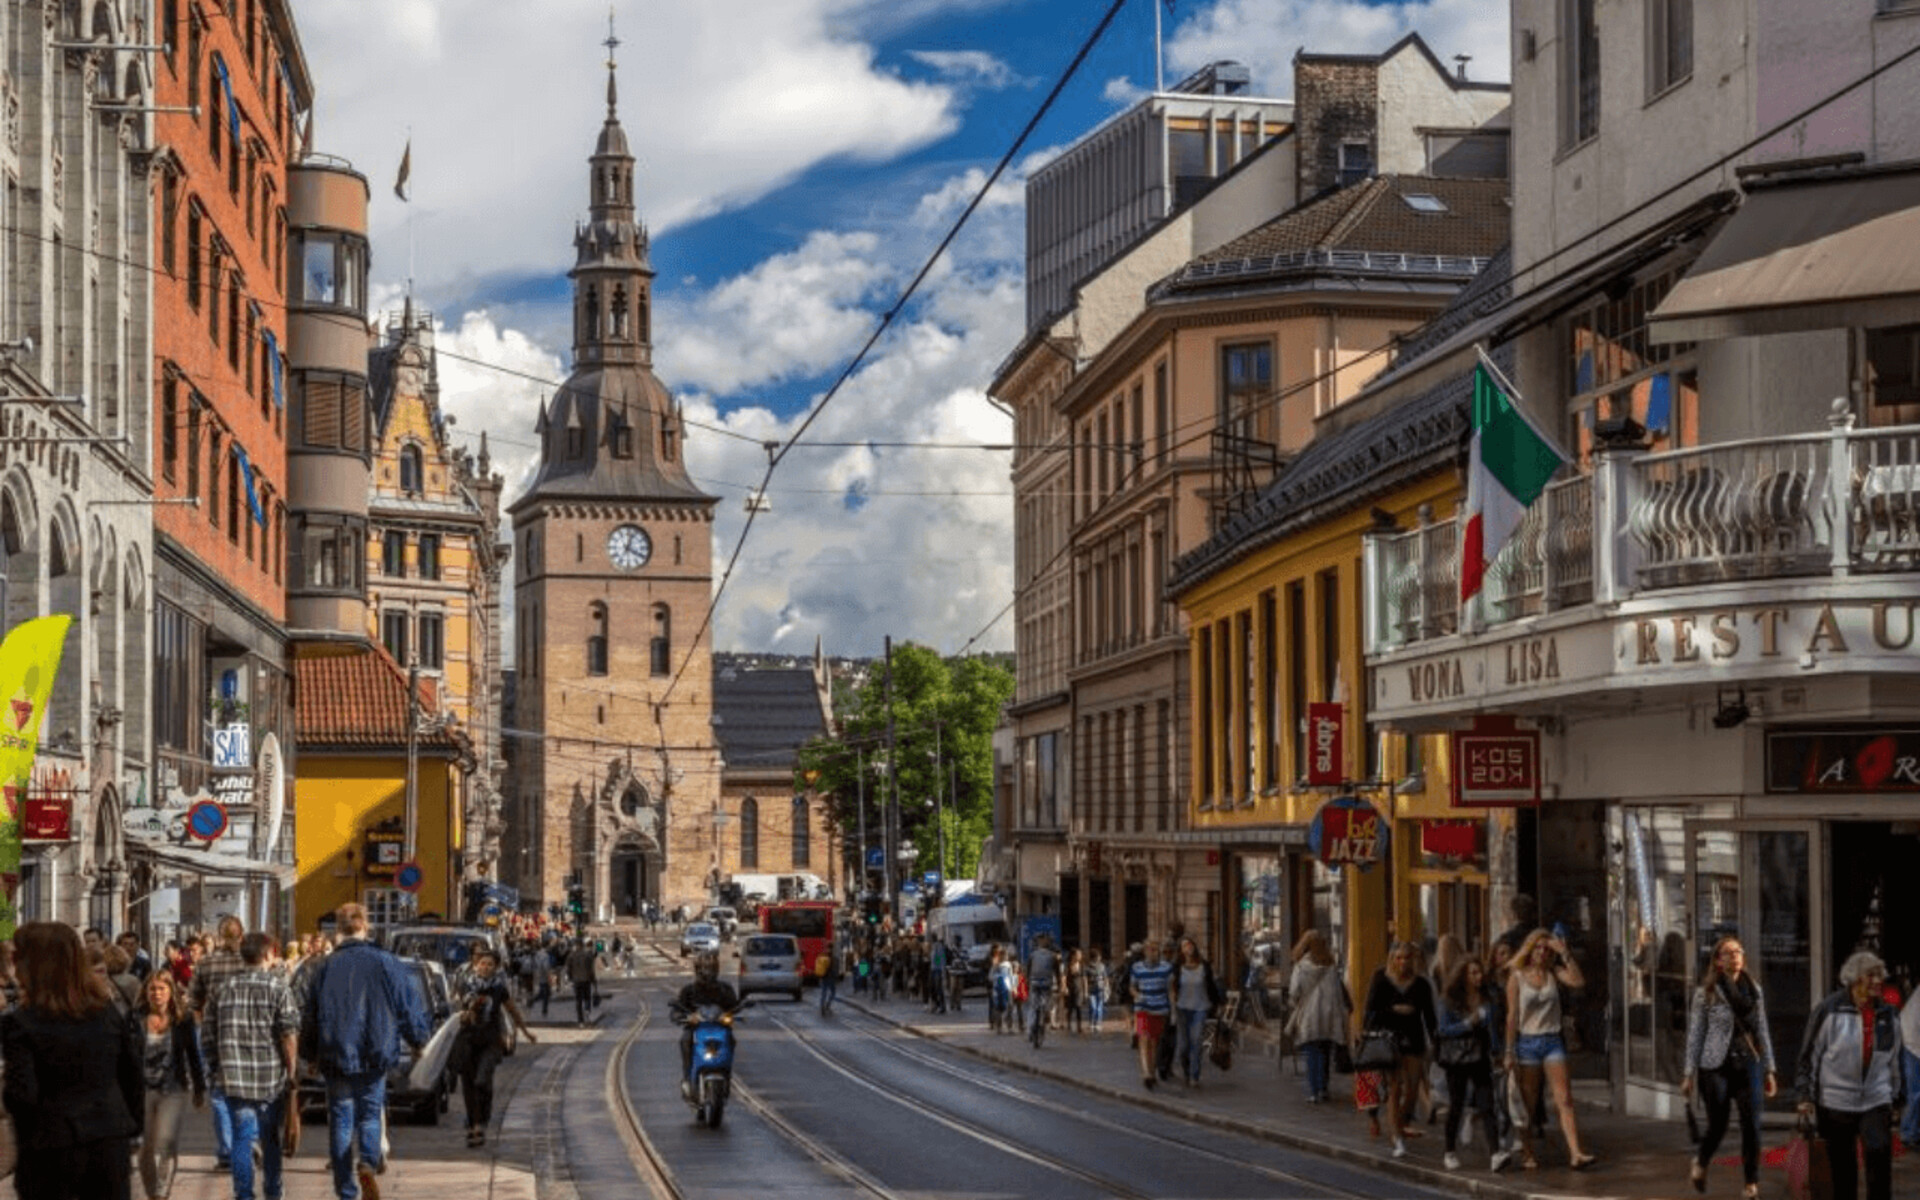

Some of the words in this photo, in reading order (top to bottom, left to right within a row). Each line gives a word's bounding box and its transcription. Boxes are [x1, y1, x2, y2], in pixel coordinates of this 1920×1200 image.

[1506, 637, 1561, 684] LISA
[1636, 601, 1917, 664] RESTAU
[1472, 747, 1523, 764] KOS
[1329, 837, 1377, 861] JAZZ
